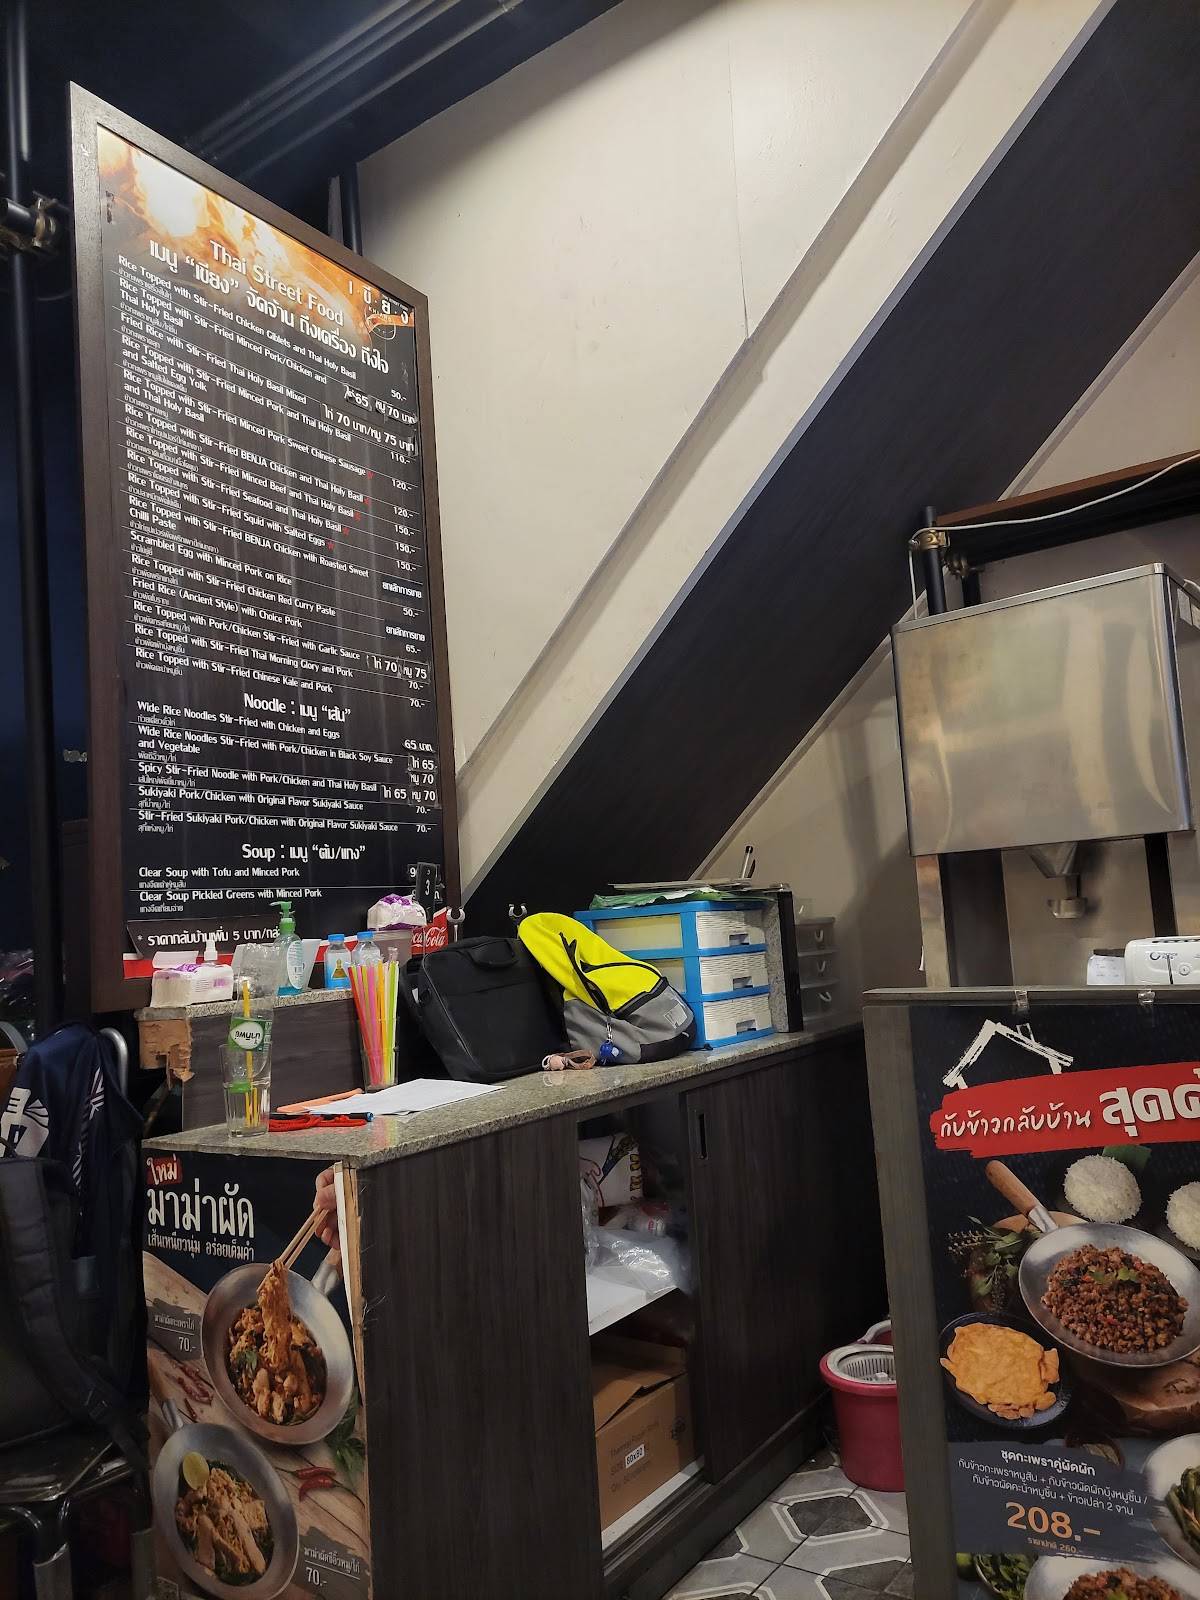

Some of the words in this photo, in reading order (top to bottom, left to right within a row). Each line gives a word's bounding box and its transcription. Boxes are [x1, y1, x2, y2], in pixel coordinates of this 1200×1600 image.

[209, 238, 246, 276] Thai
[253, 261, 302, 305] Street
[307, 292, 344, 327] Food
[149, 239, 178, 274] เมนู
[246, 284, 294, 328] จัดจ้าน
[360, 341, 388, 375] ถึงใจ
[122, 345, 137, 363] and
[141, 354, 167, 376] Salted
[170, 367, 186, 386] Egg
[189, 375, 206, 393] Yolk
[322, 403, 333, 421] ไก่
[336, 411, 350, 427] 70
[383, 431, 396, 446] 75
[386, 405, 399, 419] 70
[130, 529, 174, 553] Scrambled
[178, 543, 193, 561] Egg
[196, 549, 212, 564] with
[215, 555, 241, 572] Minced
[244, 563, 262, 578] Pork
[265, 569, 274, 582] on
[276, 572, 291, 586] Rice
[372, 655, 381, 669] ไก่
[384, 660, 397, 672] 70
[415, 667, 426, 679] 75
[243, 692, 286, 713] Noodle
[299, 704, 317, 721] เมนู
[137, 700, 159, 715] Wide
[162, 704, 181, 717] Rice
[184, 707, 216, 722] Noodles
[219, 712, 257, 728] Stir-Fried
[260, 718, 275, 730] with
[277, 720, 305, 734] Chicken
[307, 725, 320, 736] and
[322, 727, 340, 742] Eggs
[138, 724, 160, 738] Wide
[163, 727, 181, 740] Rice
[184, 730, 217, 745] Noodles
[219, 734, 258, 749] Stir-Fried
[261, 739, 276, 751] with
[279, 741, 327, 758] Pork/Chicken
[329, 748, 336, 758] in
[338, 749, 357, 761] Black
[358, 751, 371, 765] Soy
[373, 753, 392, 765] Sauce
[138, 737, 154, 750] and
[158, 739, 200, 757] Vegetable
[404, 739, 416, 749] 65
[410, 755, 419, 768] ไก่
[138, 760, 162, 777] Spicy
[165, 762, 208, 777] Stir-Fried
[211, 767, 239, 780] Noodle
[241, 770, 257, 782] with
[259, 771, 310, 787] Pork/Chicken
[311, 776, 325, 787] and
[326, 778, 342, 789] Thai
[343, 779, 359, 793] Holy
[360, 781, 376, 792] Basil
[422, 773, 434, 784] 70
[138, 785, 176, 802] Sukiyaki
[178, 788, 236, 804] Pork/Chicken
[238, 792, 254, 804] with
[257, 793, 285, 809] Original
[288, 796, 310, 807] Flavor
[312, 798, 341, 812] Sukiyaki
[343, 800, 363, 811] Sauce
[381, 784, 391, 798] ไก่
[393, 788, 406, 798] 65
[411, 791, 421, 802] หมู
[423, 790, 435, 800] 70
[241, 843, 275, 862] Soup
[289, 846, 308, 862] เมนู
[138, 866, 162, 878] Clear
[165, 866, 188, 880] Soup
[191, 866, 209, 877] with
[212, 866, 231, 877] Tofu
[234, 866, 249, 877] and
[251, 866, 278, 877] Minced
[281, 866, 299, 877] Pork
[139, 890, 162, 902] Clear
[166, 889, 189, 905] Soup
[192, 889, 222, 901] Pickled
[225, 888, 254, 900] Greens
[257, 888, 273, 899] with
[276, 887, 302, 898] Minced
[304, 887, 321, 897] Pork
[233, 931, 240, 941] 5
[940, 1102, 1090, 1138] กับข้าวกลับบ้าน
[147, 1153, 178, 1185] ใหม่
[147, 1178, 254, 1238] มาม่าผัด
[206, 1237, 255, 1261] อร่อยเต็มคำ
[1001, 1450, 1095, 1476] ชุดกะเพราคู่ผัดผัก
[1067, 1491, 1105, 1510] ข้าวเปล่า
[1107, 1502, 1113, 1511] 2
[1115, 1504, 1133, 1515] จาน
[1006, 1501, 1100, 1542] 208.-
[306, 1567, 327, 1586] 70.-
